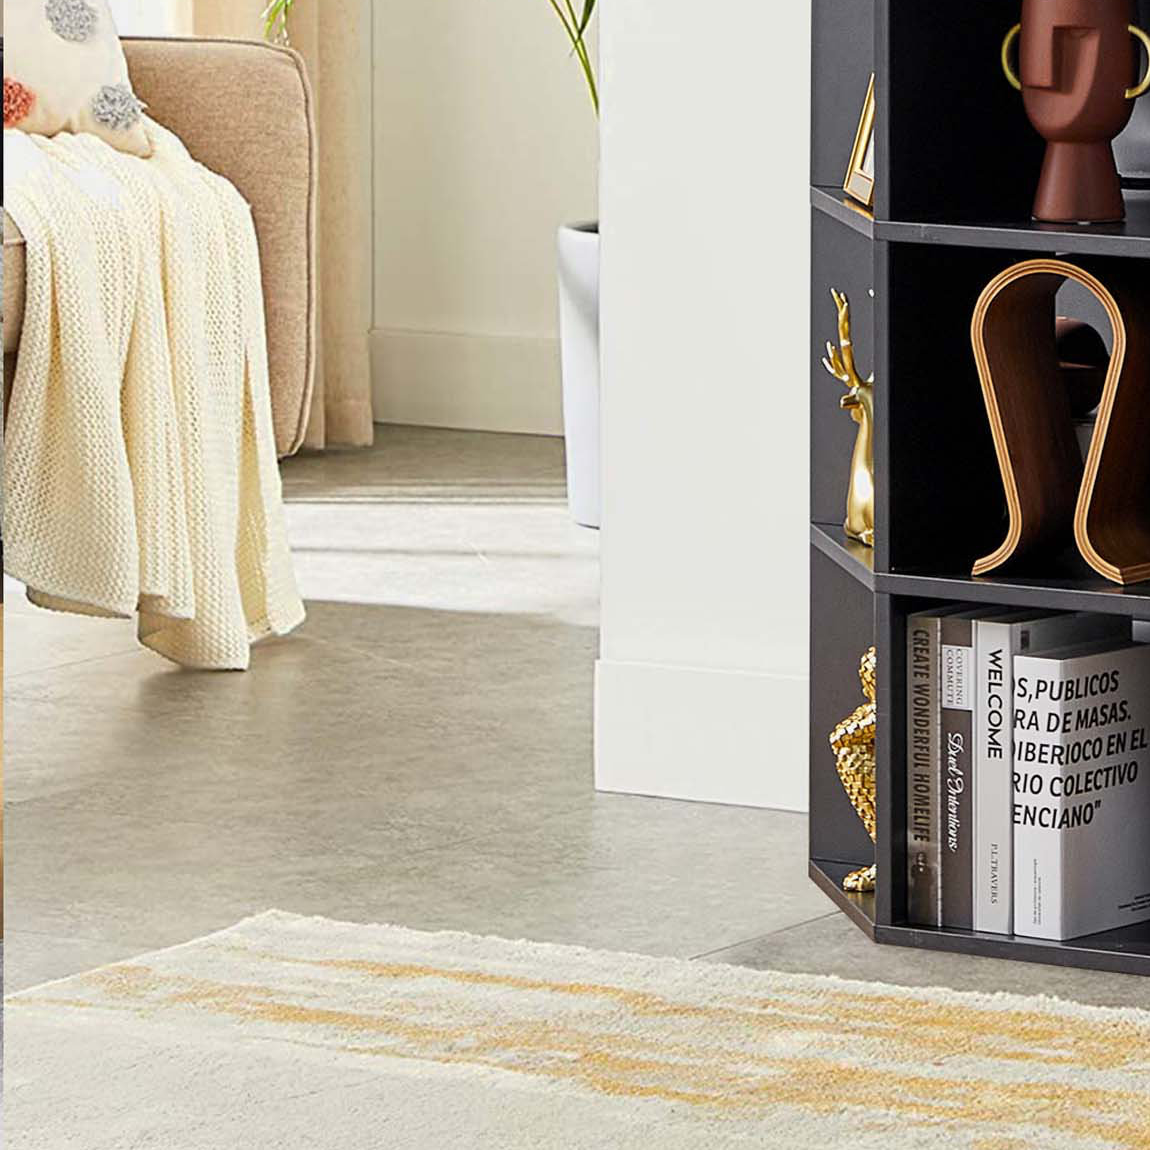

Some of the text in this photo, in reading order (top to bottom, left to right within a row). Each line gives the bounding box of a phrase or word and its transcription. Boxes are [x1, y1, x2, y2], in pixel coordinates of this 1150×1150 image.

[988, 649, 1003, 760] WELCOME
[1013, 670, 1119, 703] S,PUBLICOS
[1046, 711, 1072, 733] DE
[1075, 700, 1132, 732] MASAS.
[912, 629, 931, 843] CREATE WONDERFUL HOMELIFE
[1013, 728, 1148, 766] IBERIOCO EN EL
[1050, 760, 1138, 798] COLECTIVO
